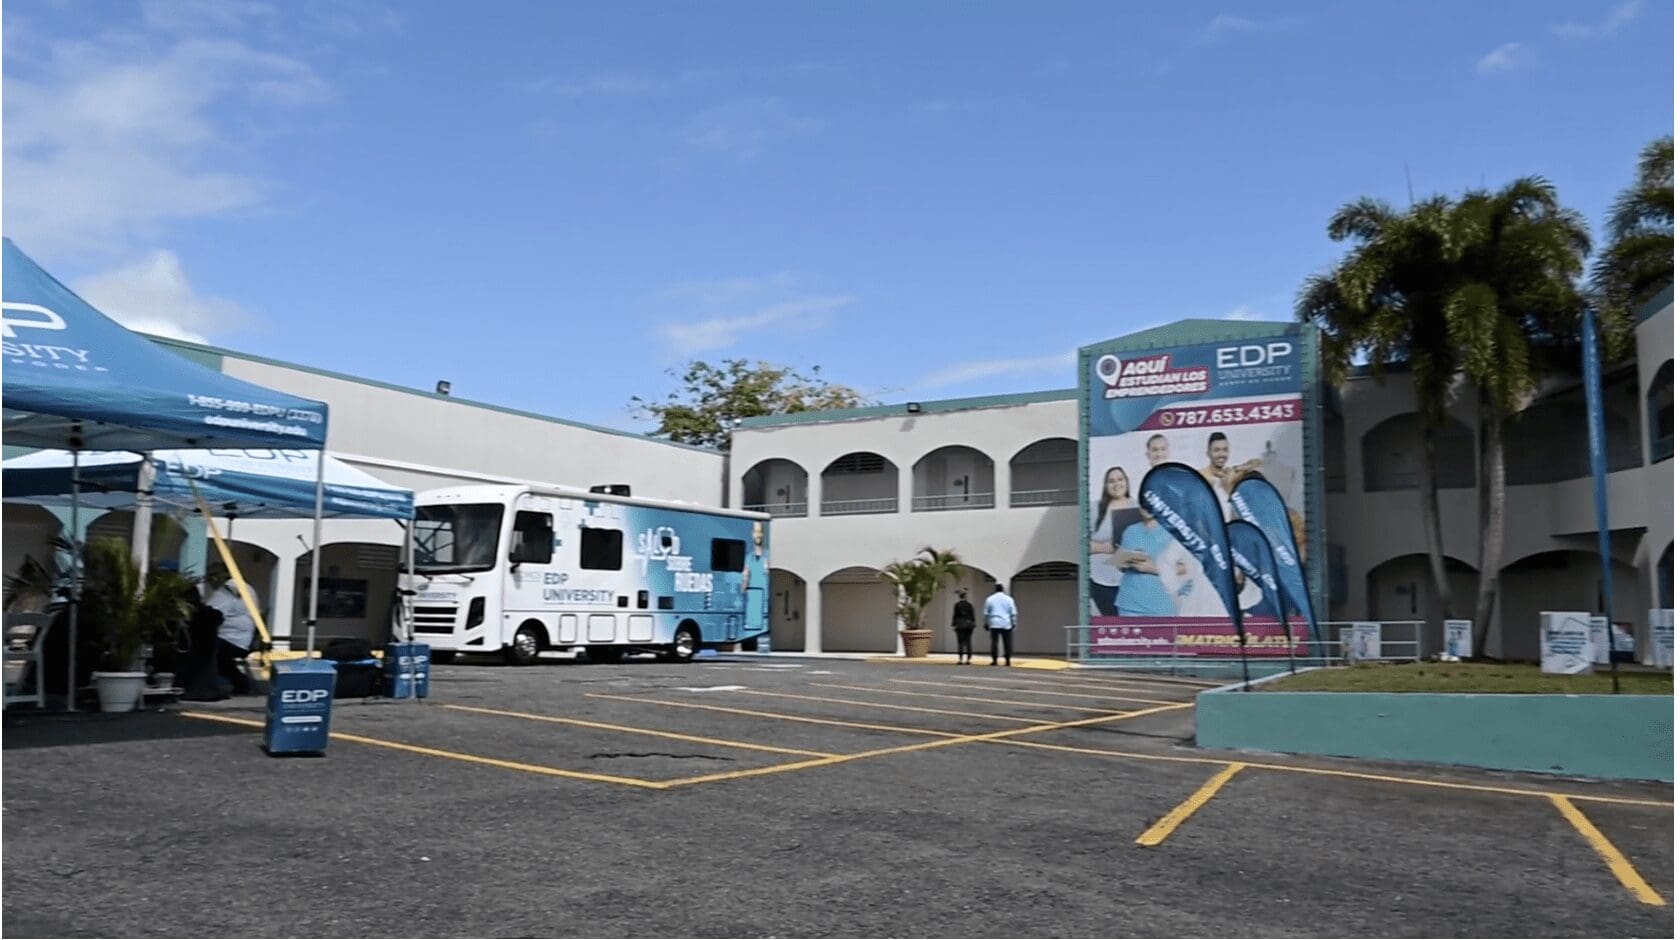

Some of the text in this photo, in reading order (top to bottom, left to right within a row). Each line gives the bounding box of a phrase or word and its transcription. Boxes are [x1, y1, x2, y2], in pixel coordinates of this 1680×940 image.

[1217, 343, 1292, 368] EDP
[1122, 355, 1169, 376] AQUÍ
[1182, 370, 1207, 381] LOS
[1176, 404, 1294, 425] 787.653.4343
[1144, 490, 1207, 550] UNIVERSITY
[543, 572, 569, 585] EDP
[543, 588, 615, 602] UNIVERSITY
[280, 689, 329, 703] EDP
